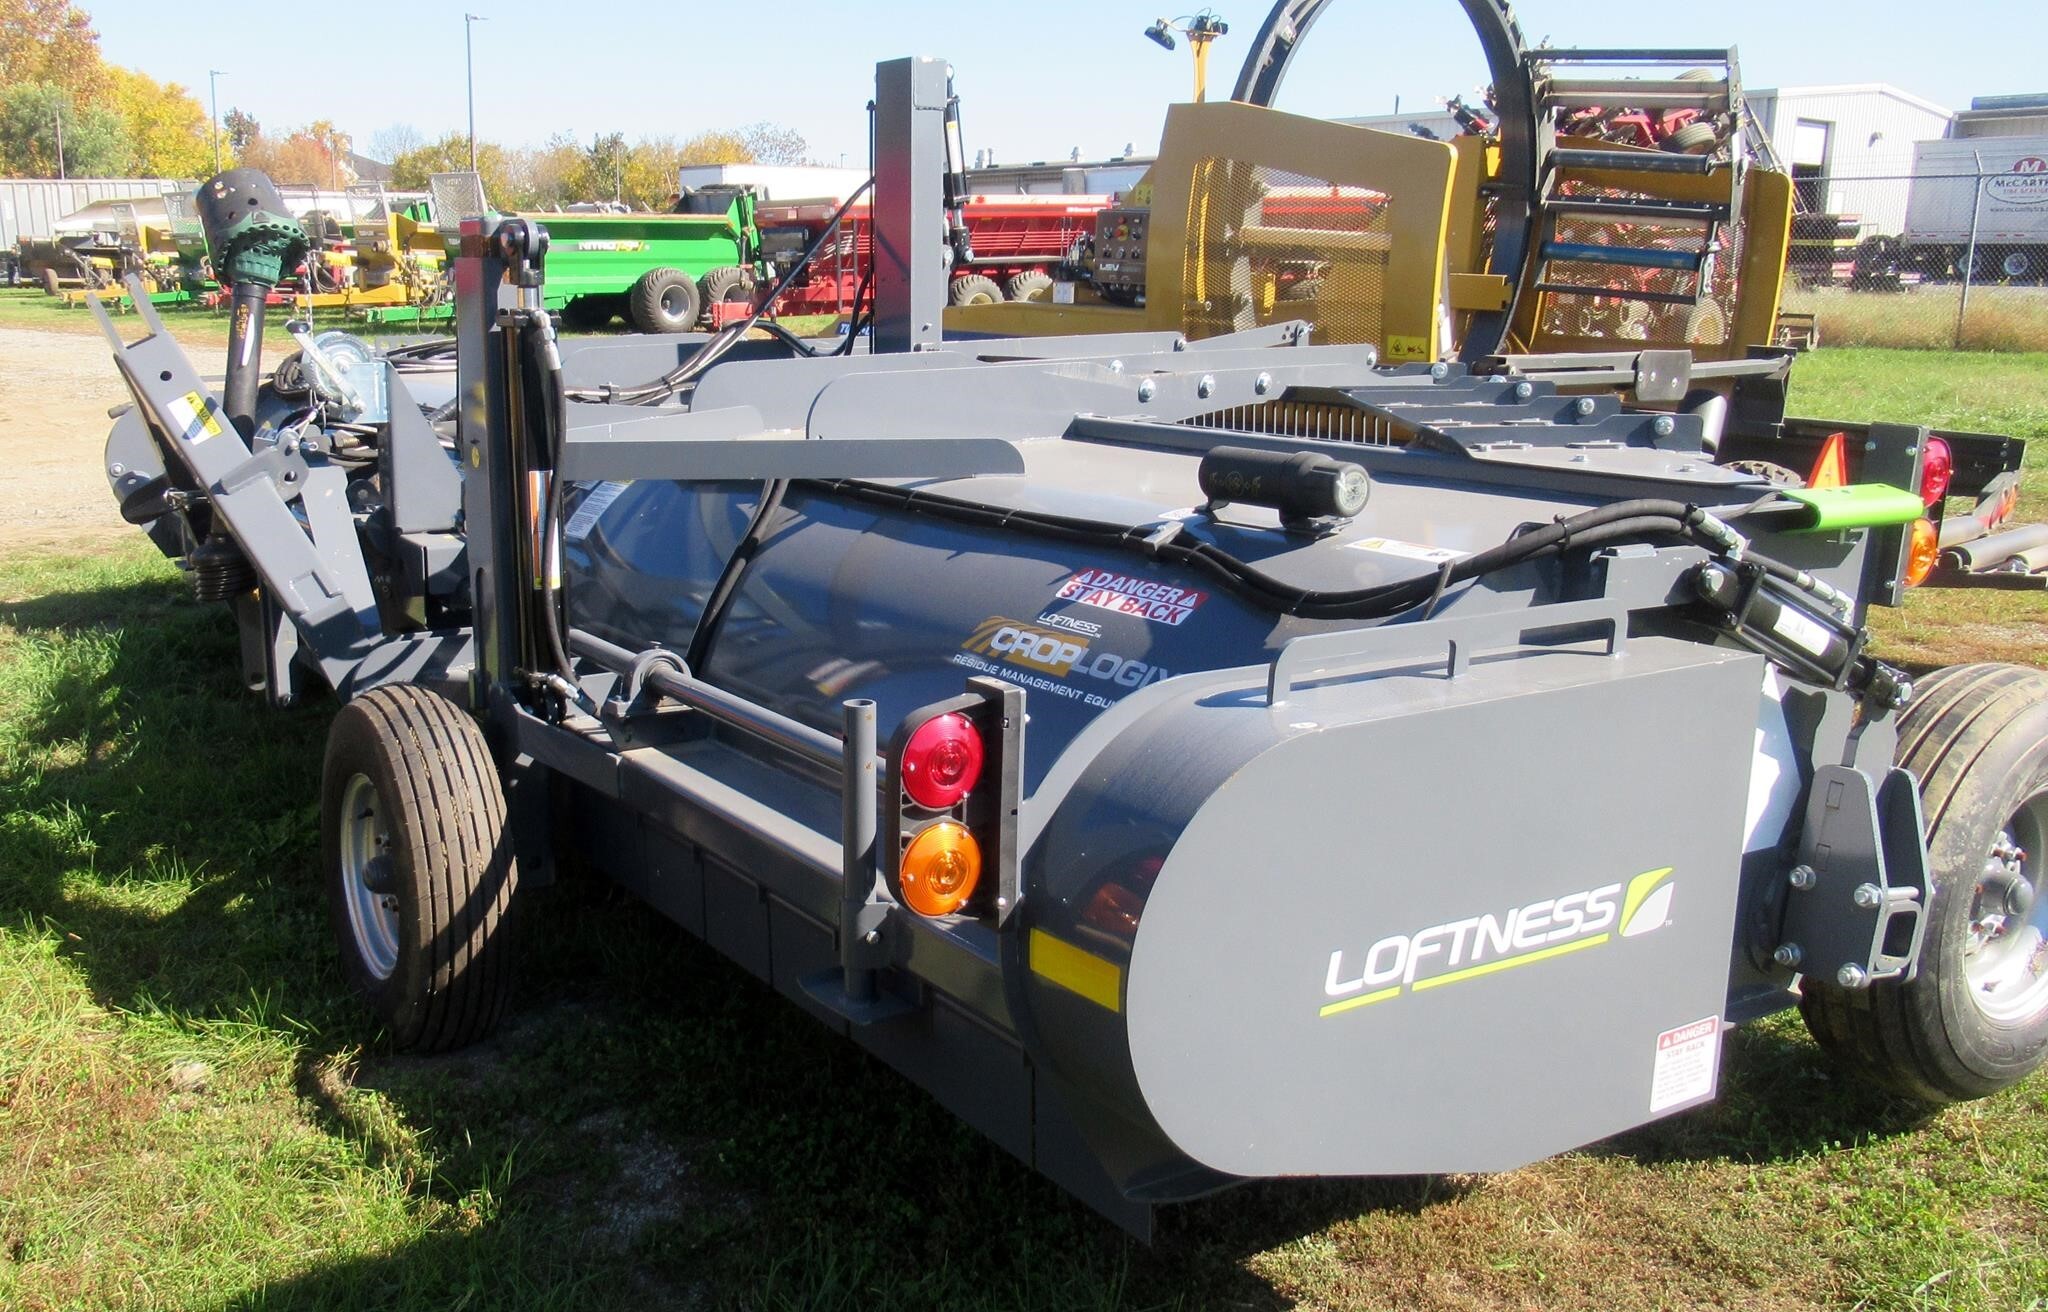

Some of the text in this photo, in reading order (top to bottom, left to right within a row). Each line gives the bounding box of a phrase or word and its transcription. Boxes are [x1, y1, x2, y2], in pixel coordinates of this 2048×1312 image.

[2019, 160, 2041, 173] M
[1091, 572, 1185, 603] DANGER
[1061, 584, 1187, 624] STAY BACK
[1038, 612, 1102, 633] LOFTNESS
[952, 654, 998, 675] RESIDUE
[1000, 668, 1084, 700] MANAGEMENT
[1324, 882, 1622, 997] LOFTNESS
[1673, 1021, 1713, 1042] DANGER
